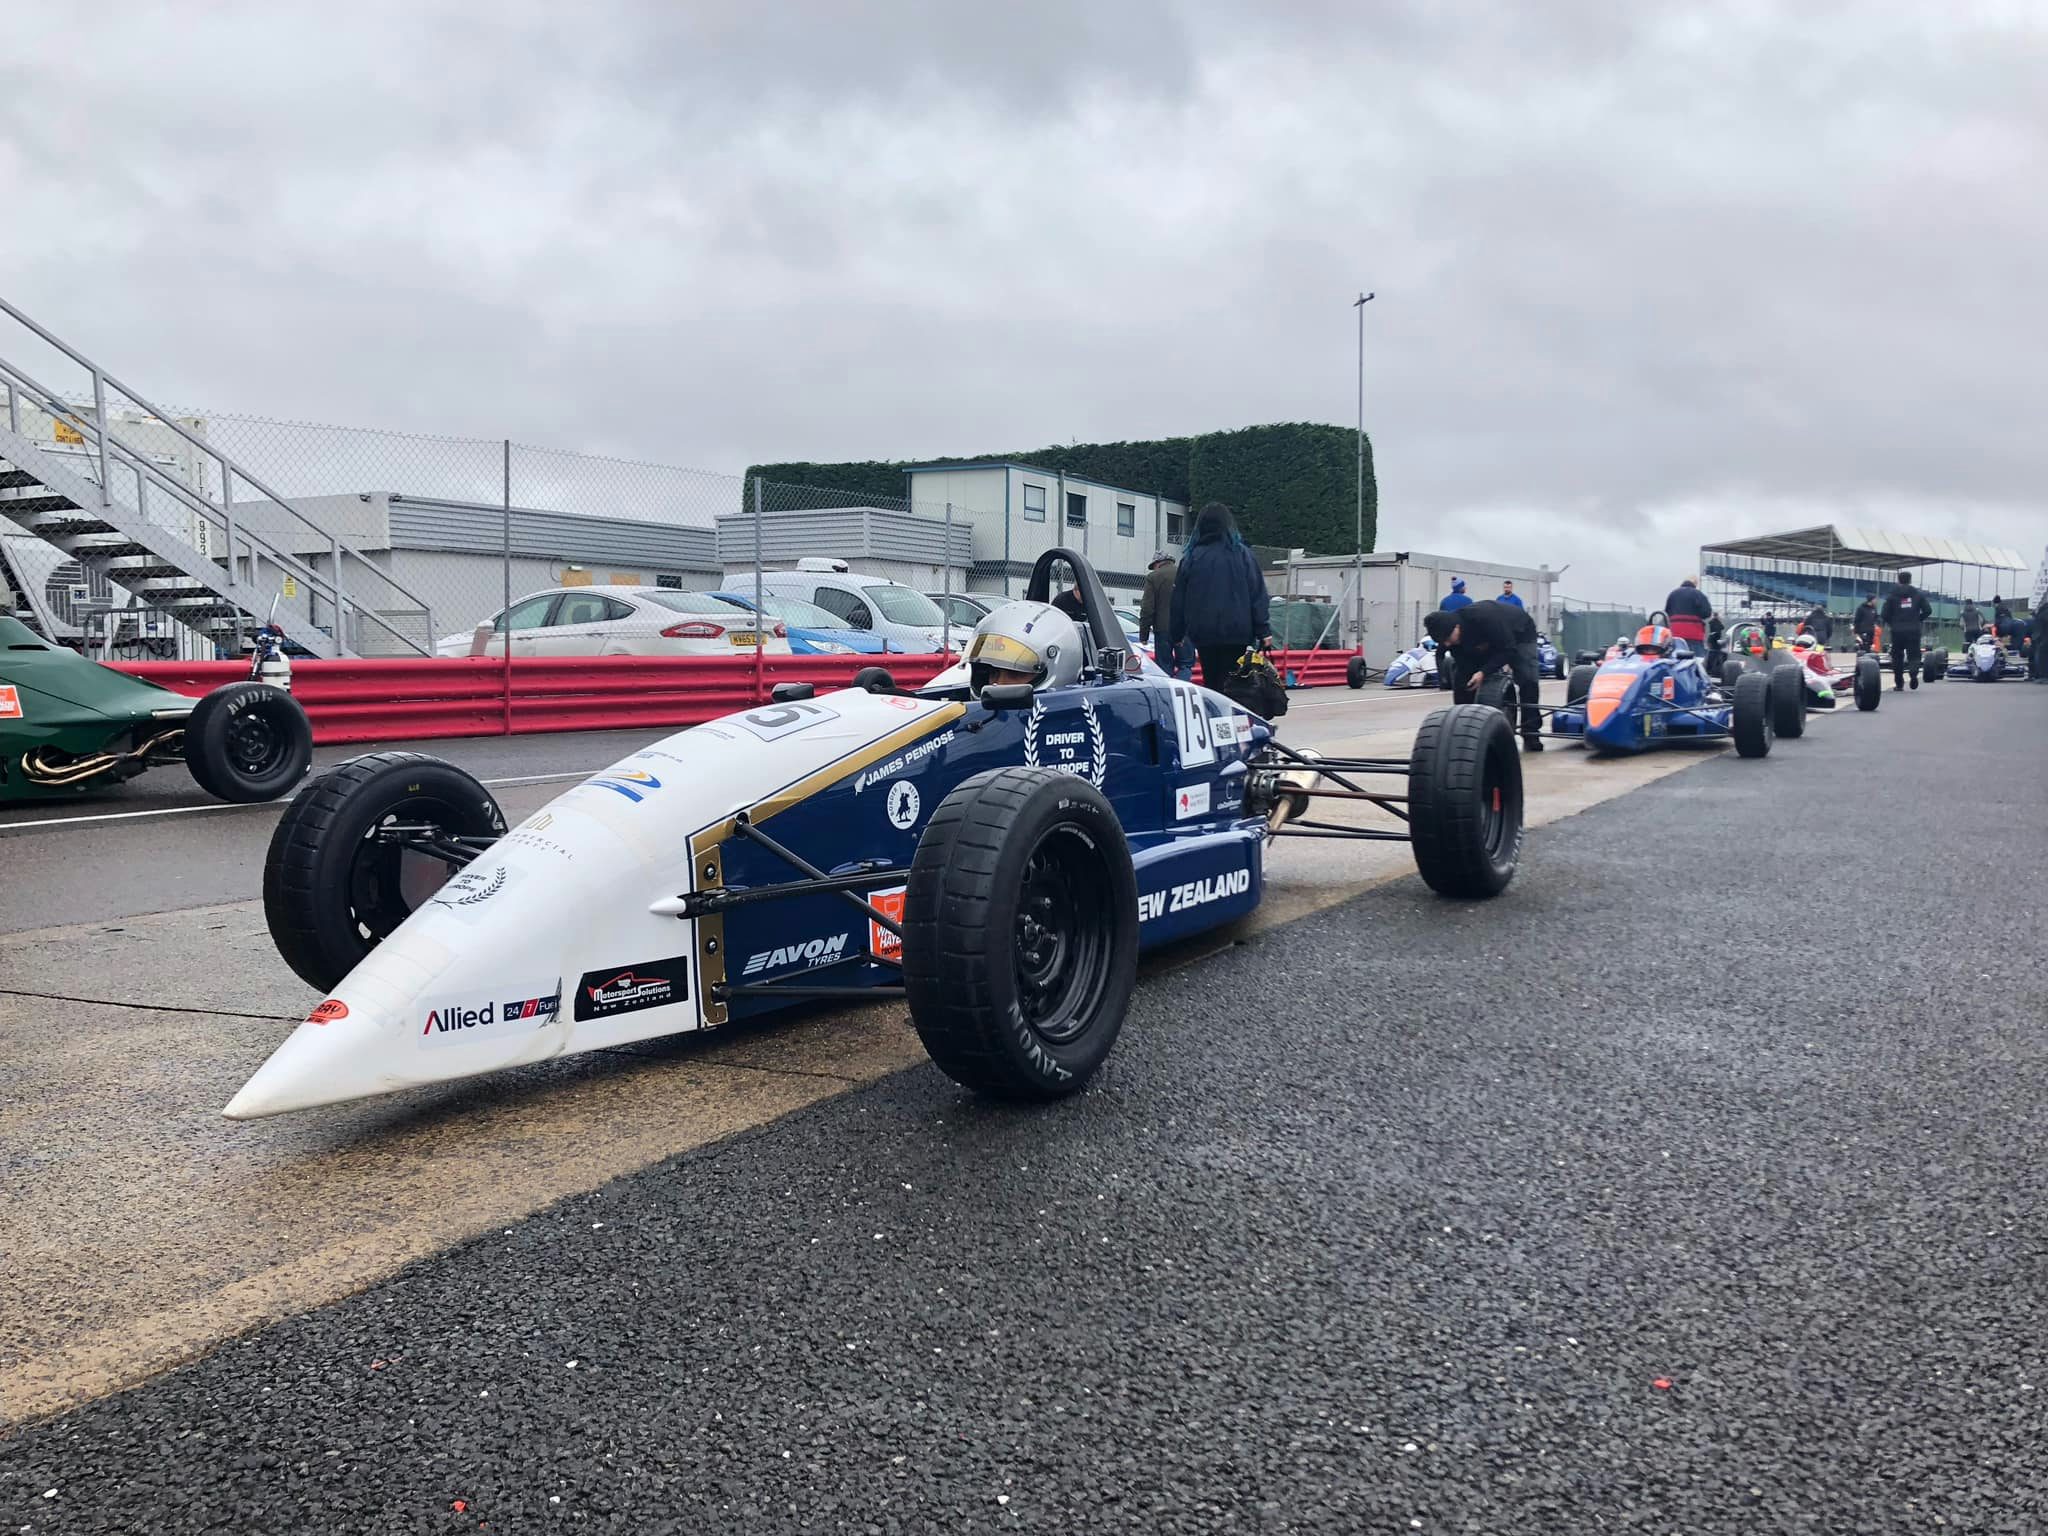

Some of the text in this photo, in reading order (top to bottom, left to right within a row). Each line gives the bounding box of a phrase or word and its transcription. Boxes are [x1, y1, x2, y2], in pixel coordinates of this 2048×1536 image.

[1175, 687, 1206, 752] 75
[1046, 732, 1085, 746] DRIVER
[866, 729, 955, 786] JAMES PENROSE
[1059, 747, 1075, 760] TO
[1137, 868, 1250, 922] EW ZEALAND
[764, 932, 849, 969] AVON
[807, 951, 842, 968] TYRES
[593, 986, 637, 1004] Motorsport
[593, 992, 672, 1012] New Zealand
[423, 1000, 495, 1035] Allied
